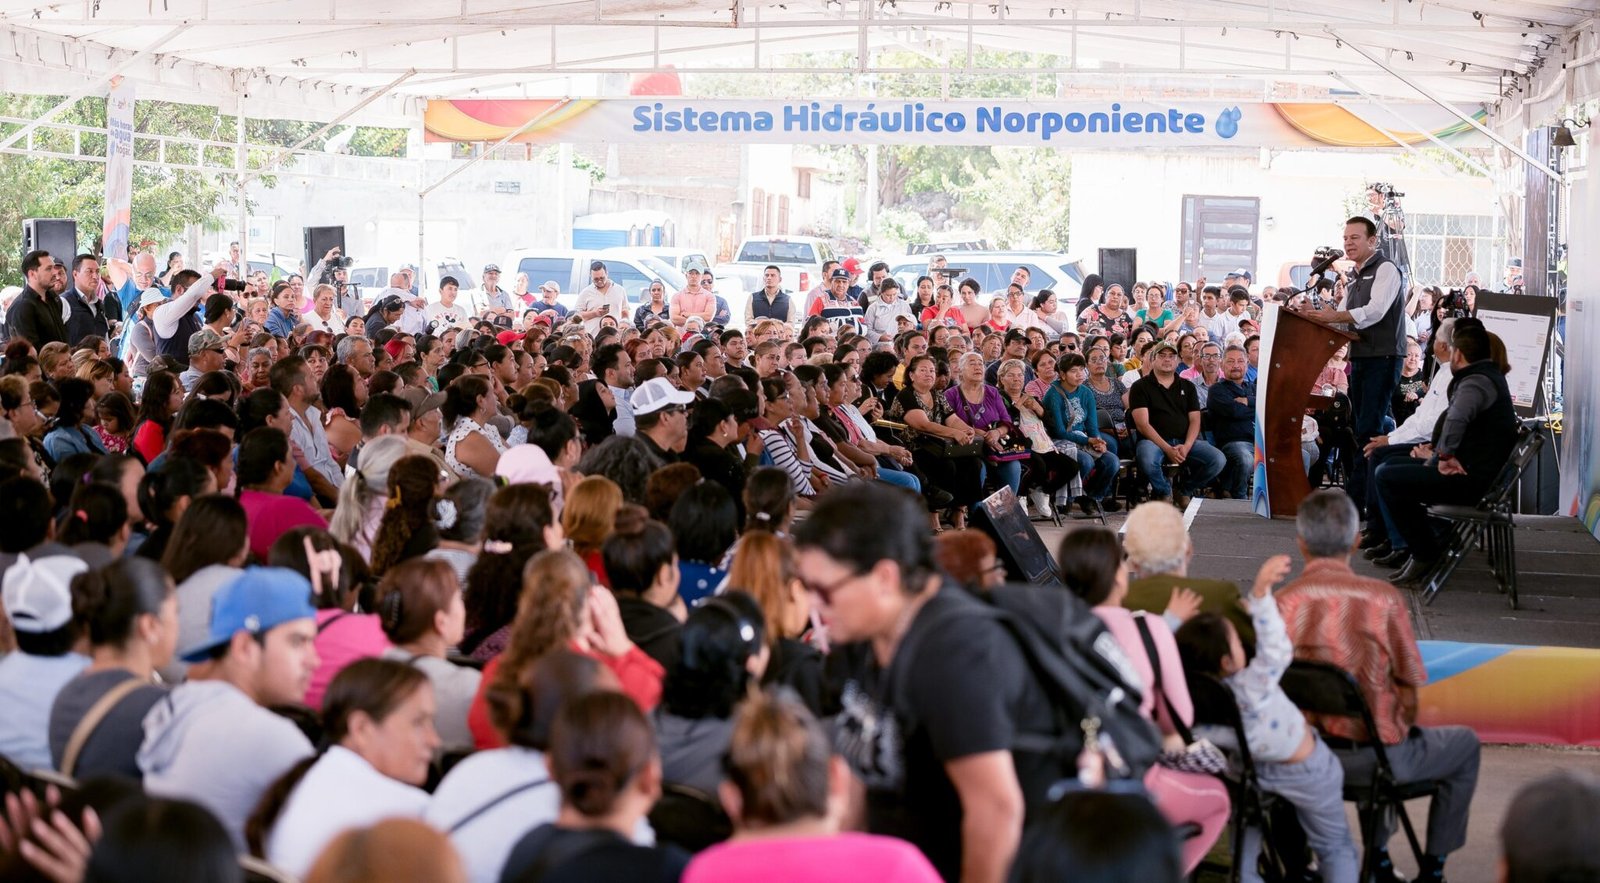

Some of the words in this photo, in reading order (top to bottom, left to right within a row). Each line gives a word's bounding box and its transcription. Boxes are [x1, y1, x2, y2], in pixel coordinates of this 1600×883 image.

[633, 102, 773, 132] Sistema
[783, 102, 967, 132] Hidráulico
[976, 103, 1205, 140] Norponiente
[115, 128, 131, 143] agua
